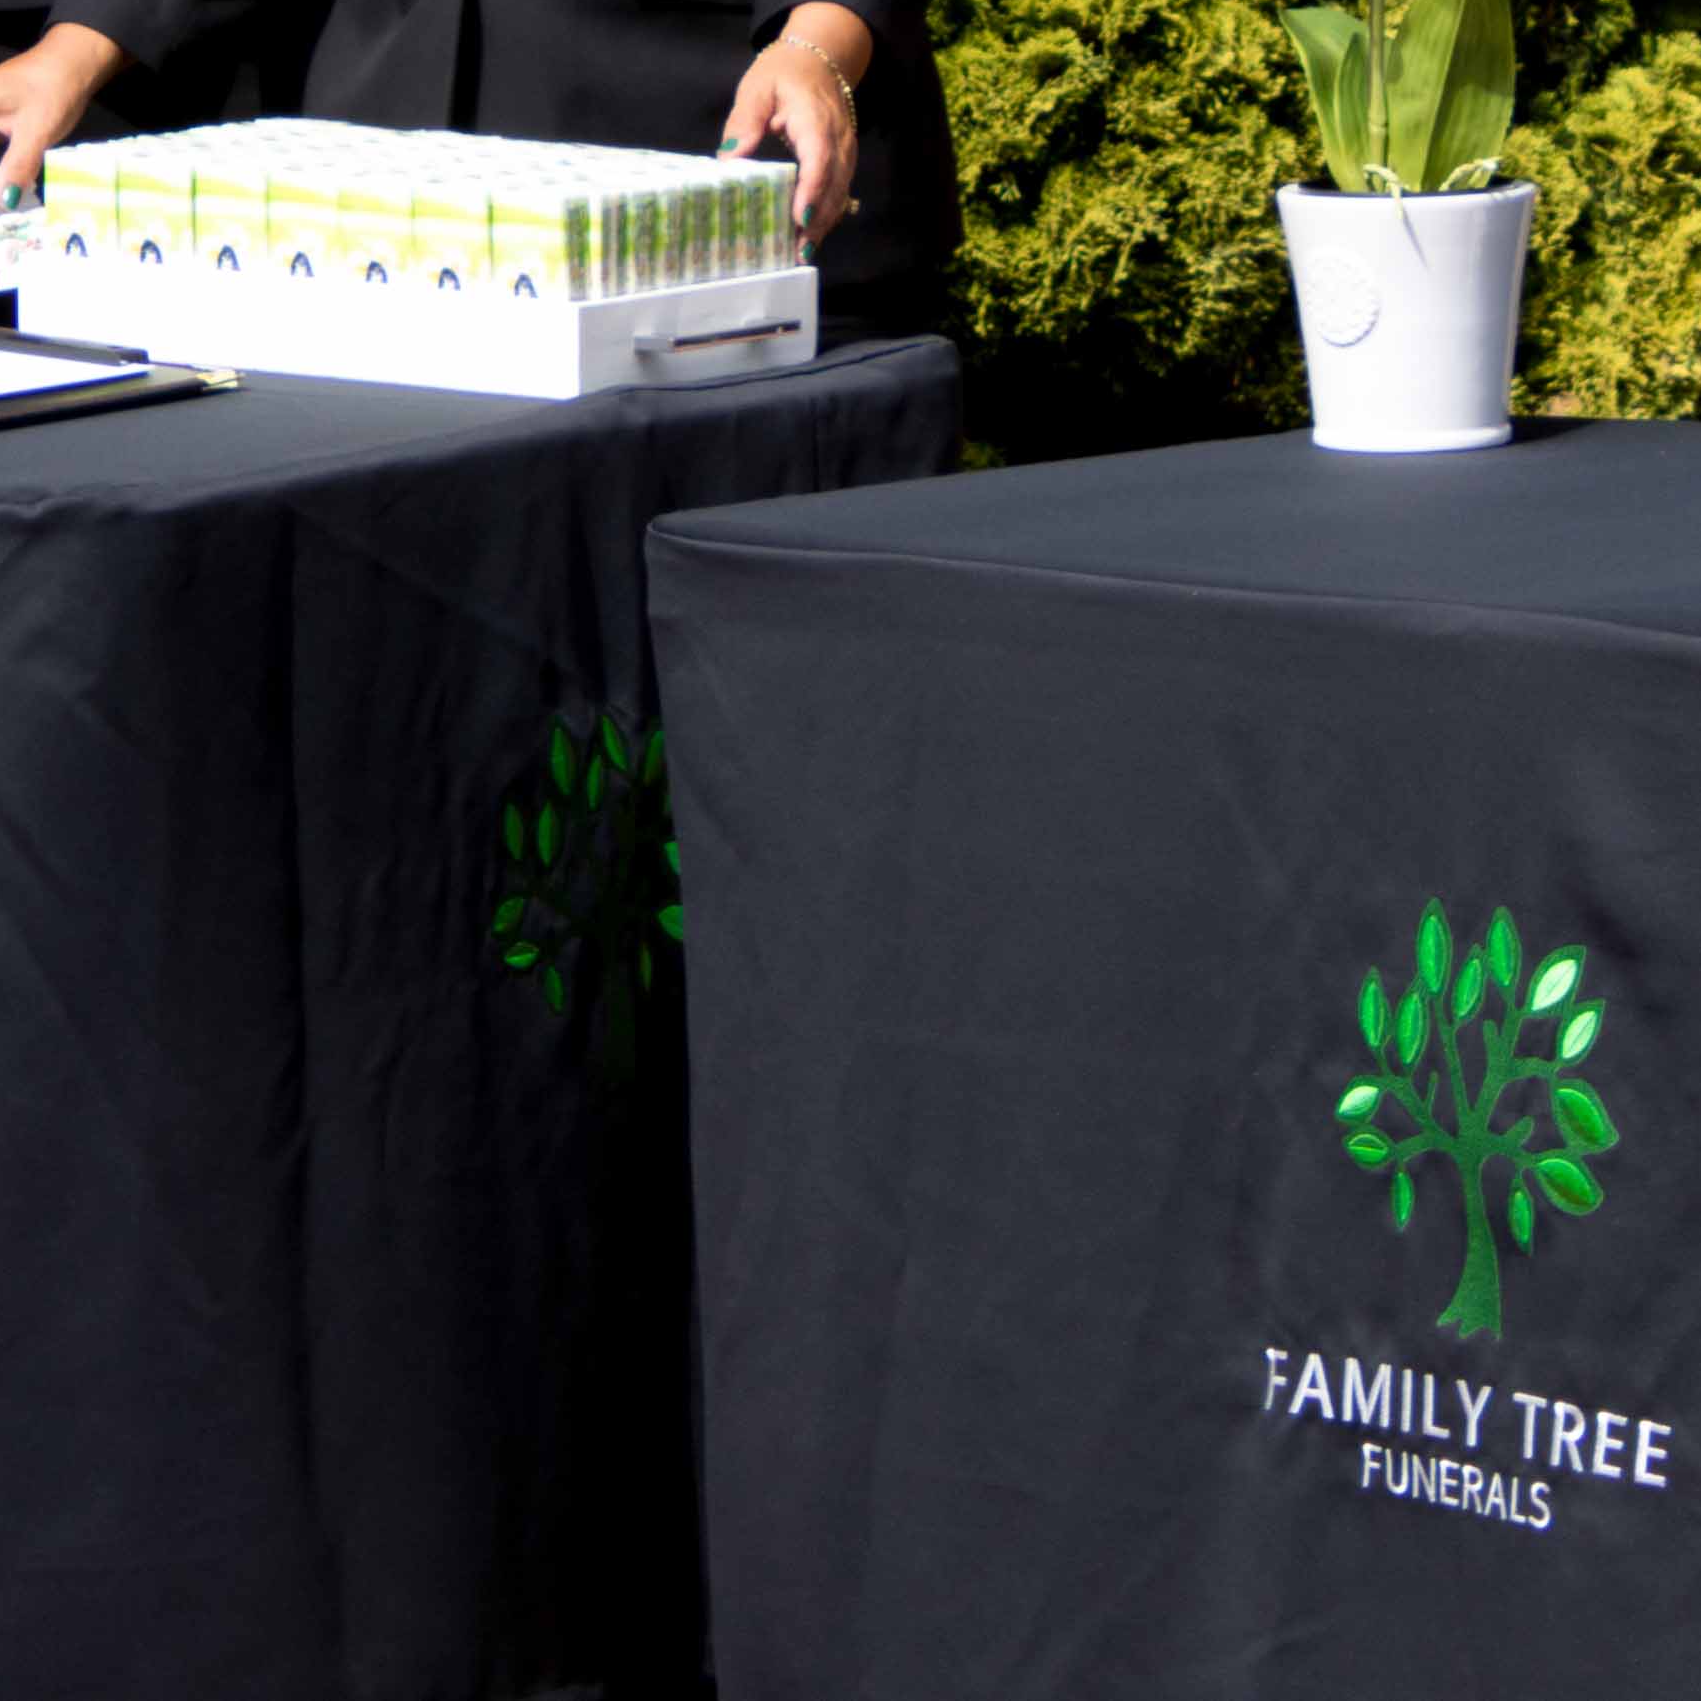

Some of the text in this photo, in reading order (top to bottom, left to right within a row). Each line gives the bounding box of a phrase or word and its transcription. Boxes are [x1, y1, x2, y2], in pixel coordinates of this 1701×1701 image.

[1264, 1347, 1673, 1488] FAMILY TREE
[1361, 1442, 1553, 1529] FUNERALS
